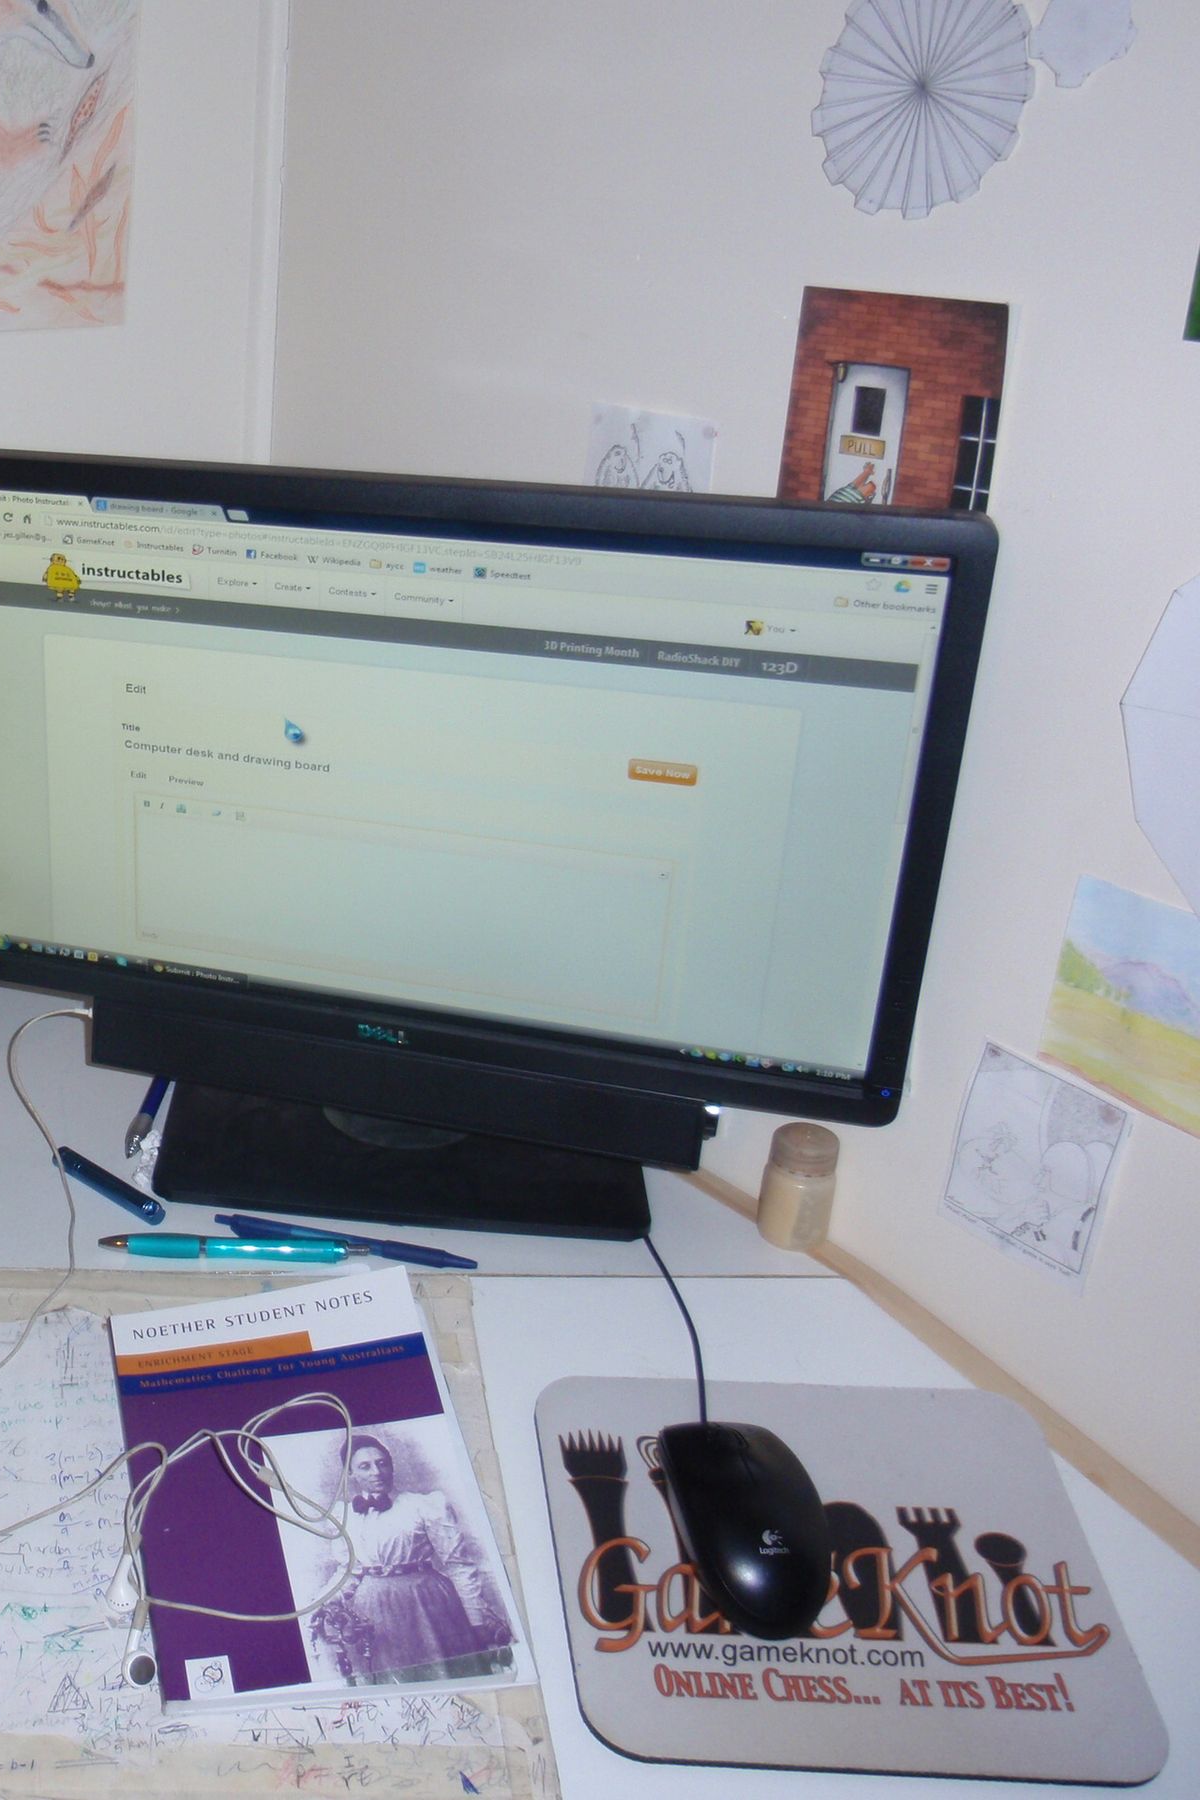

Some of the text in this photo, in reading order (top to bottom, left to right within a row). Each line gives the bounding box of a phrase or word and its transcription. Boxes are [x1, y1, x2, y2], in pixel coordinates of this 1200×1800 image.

[847, 439, 876, 457] PULL
[81, 562, 183, 585] instructables
[559, 642, 603, 657] Printing
[604, 646, 640, 658] Month
[125, 683, 147, 695] Edit
[124, 739, 331, 774] Computer desk and drawing board
[132, 1290, 374, 1341] NOETHER STUDENT NOTES
[137, 1344, 254, 1369] ENRICHMENT STAGE
[138, 1343, 405, 1389] Mathematics Challenge for Young Australians
[647, 1639, 926, 1668] www.gameknot.com
[652, 1663, 1077, 1712] ONLINE CHESS... AT ITS BEST!
